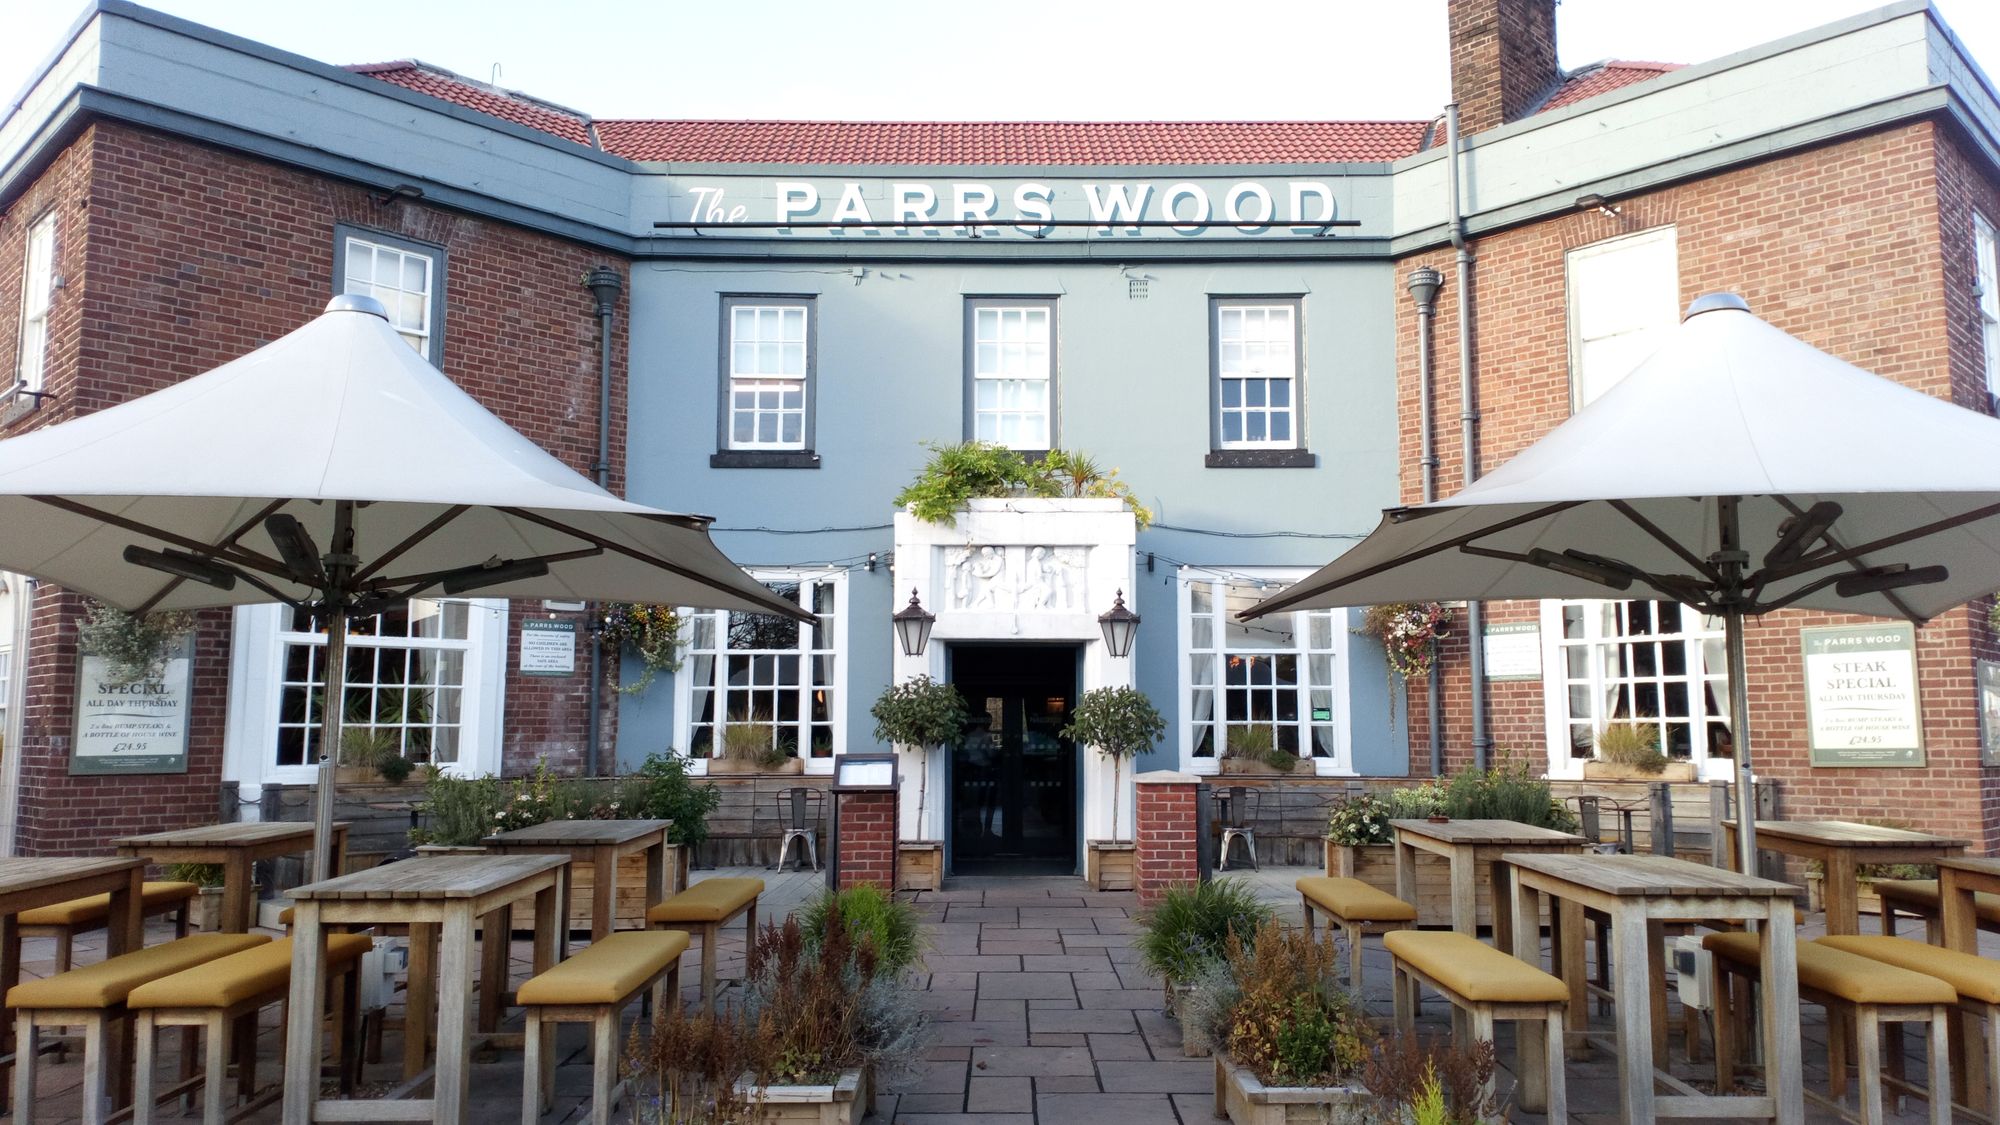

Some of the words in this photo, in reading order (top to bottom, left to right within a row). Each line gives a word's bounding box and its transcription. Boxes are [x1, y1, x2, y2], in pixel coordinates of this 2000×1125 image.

[688, 186, 749, 225] The
[776, 182, 1053, 234] PARRS
[1082, 182, 1336, 234] WOOD
[1824, 637, 1862, 645] PARRS
[1865, 635, 1901, 644] WOOD
[1833, 661, 1887, 672] STEAK
[1827, 677, 1896, 689] SPECIAL
[1837, 694, 1853, 702] DAY
[1857, 693, 1906, 701] THURSDAY
[112, 742, 148, 752] £24.95
